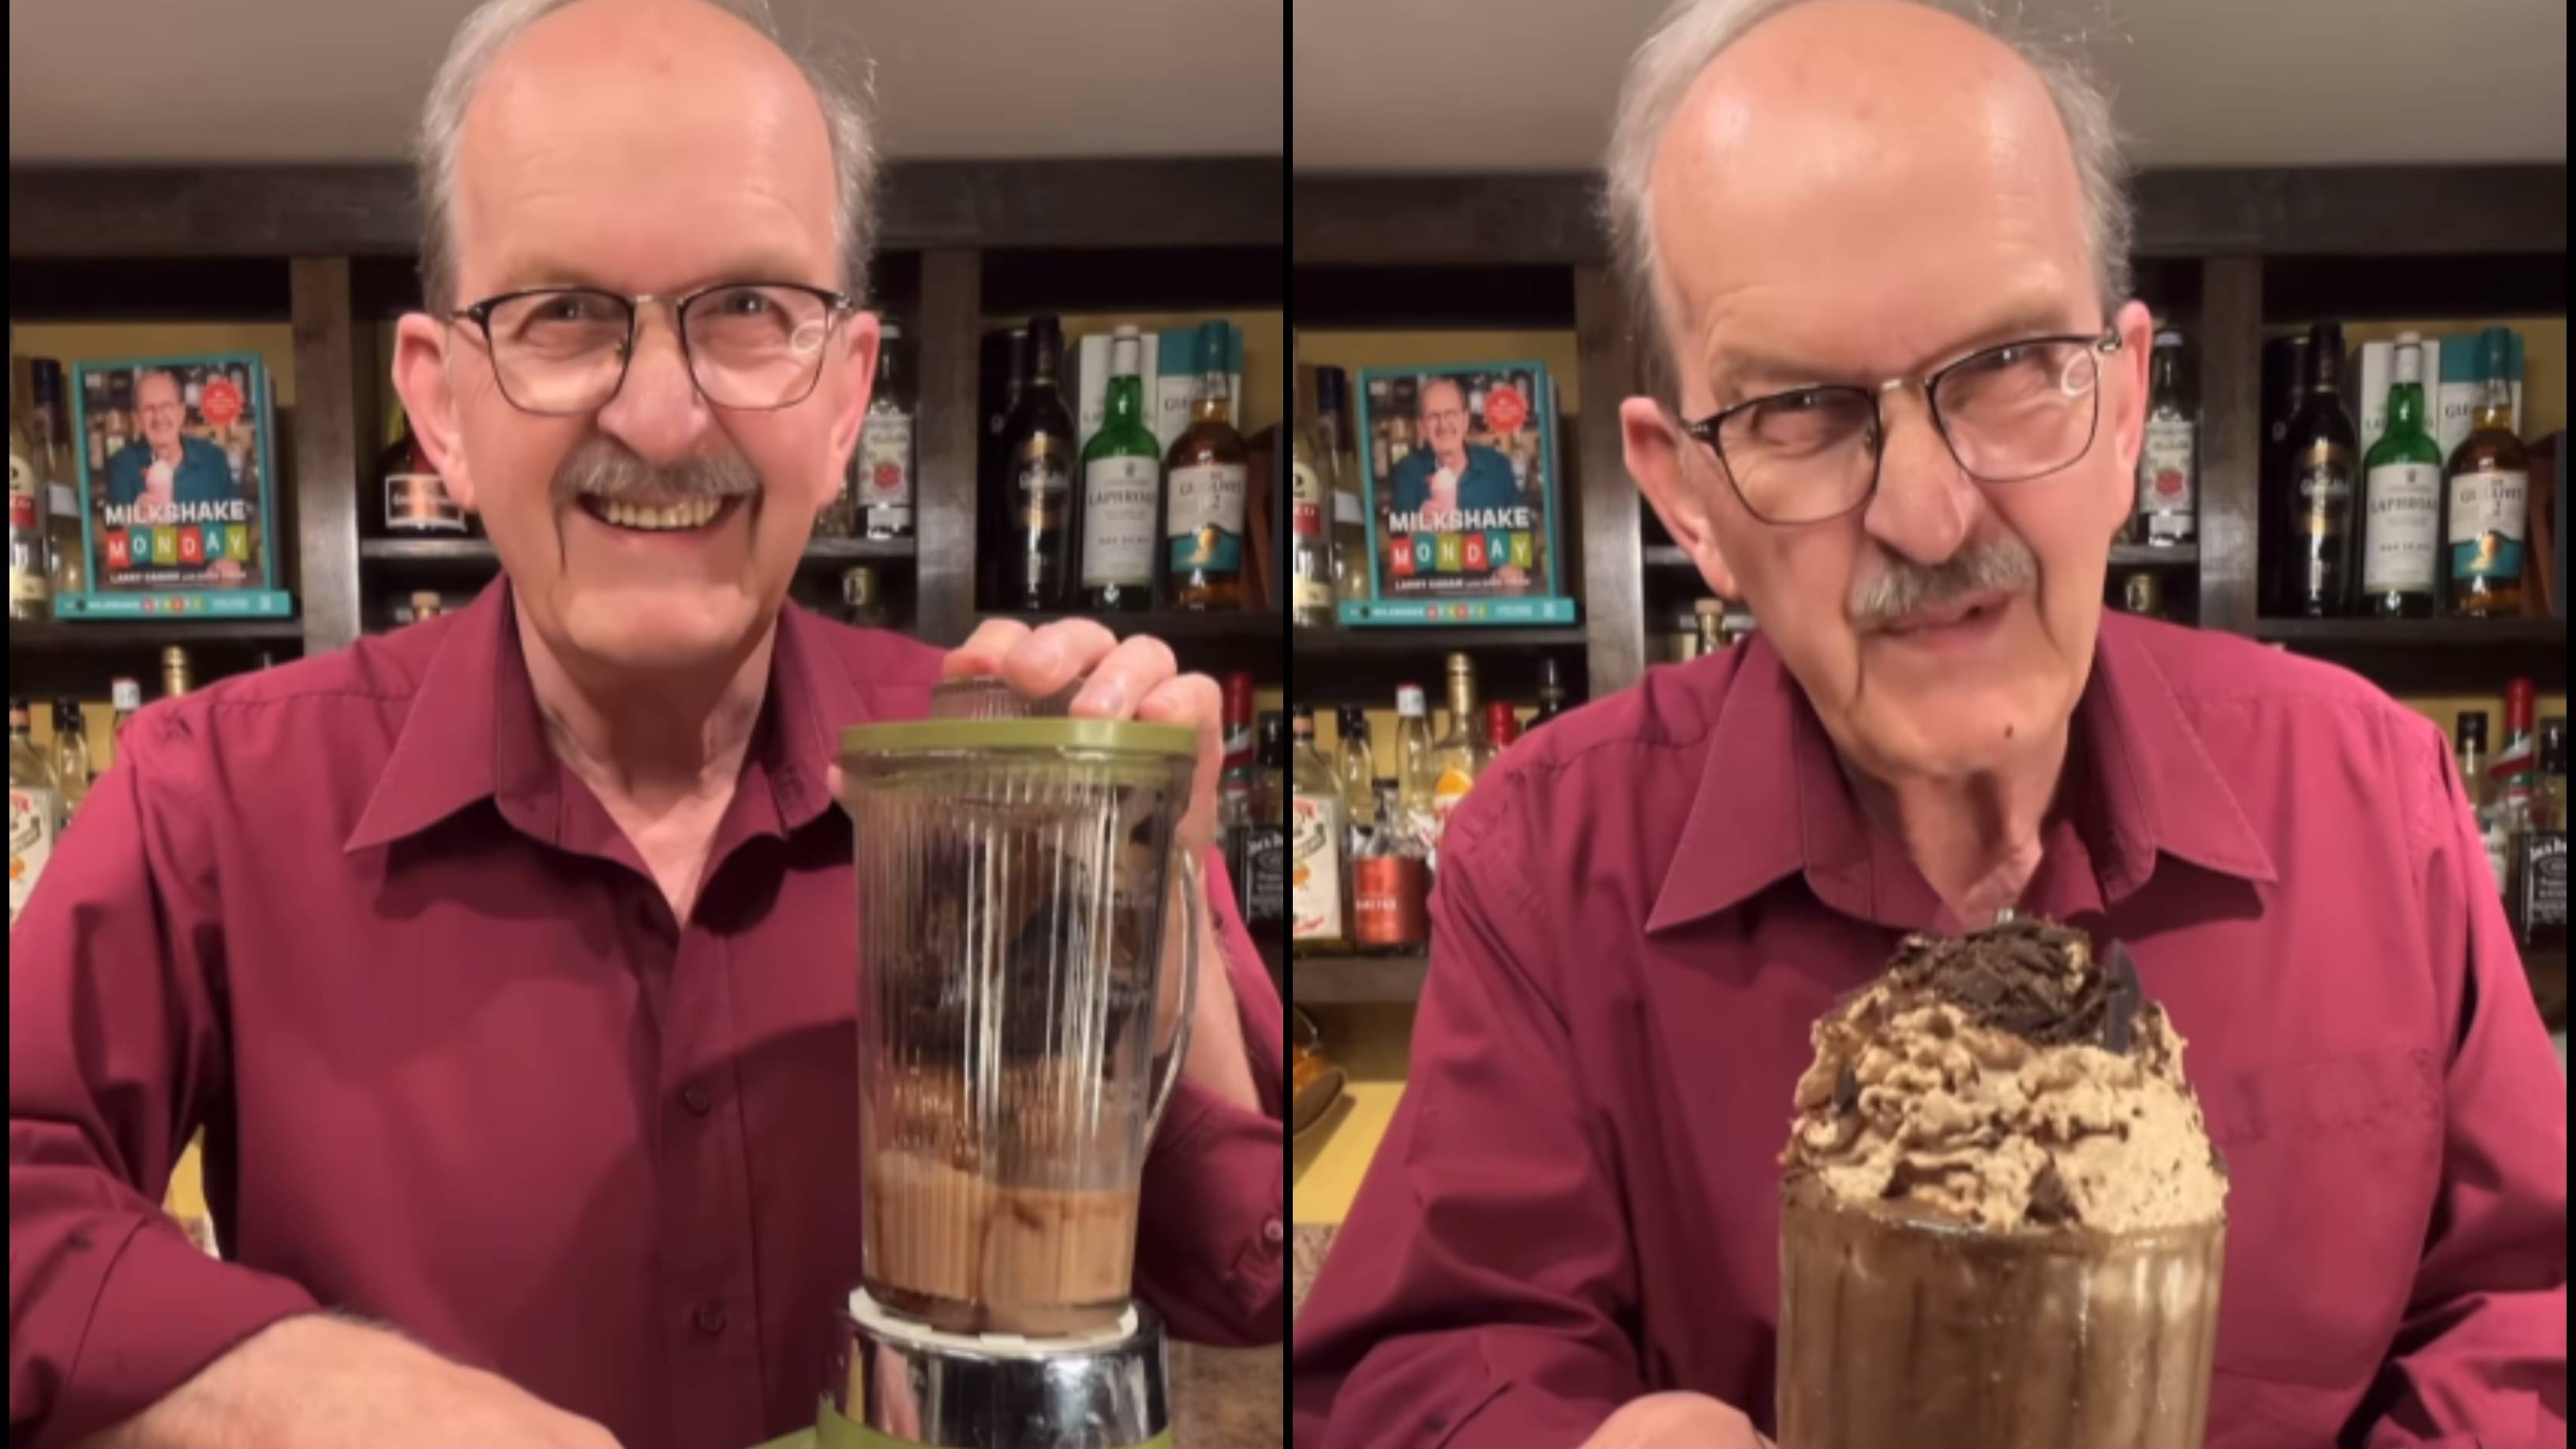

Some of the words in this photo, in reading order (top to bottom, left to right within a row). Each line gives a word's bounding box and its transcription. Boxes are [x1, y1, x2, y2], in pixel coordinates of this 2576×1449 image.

[105, 500, 245, 526] MILKSHAKE
[1389, 507, 1530, 533] MILKSHAKE
[109, 531, 242, 563] MONDAY
[1395, 538, 1528, 565] MONDAY
